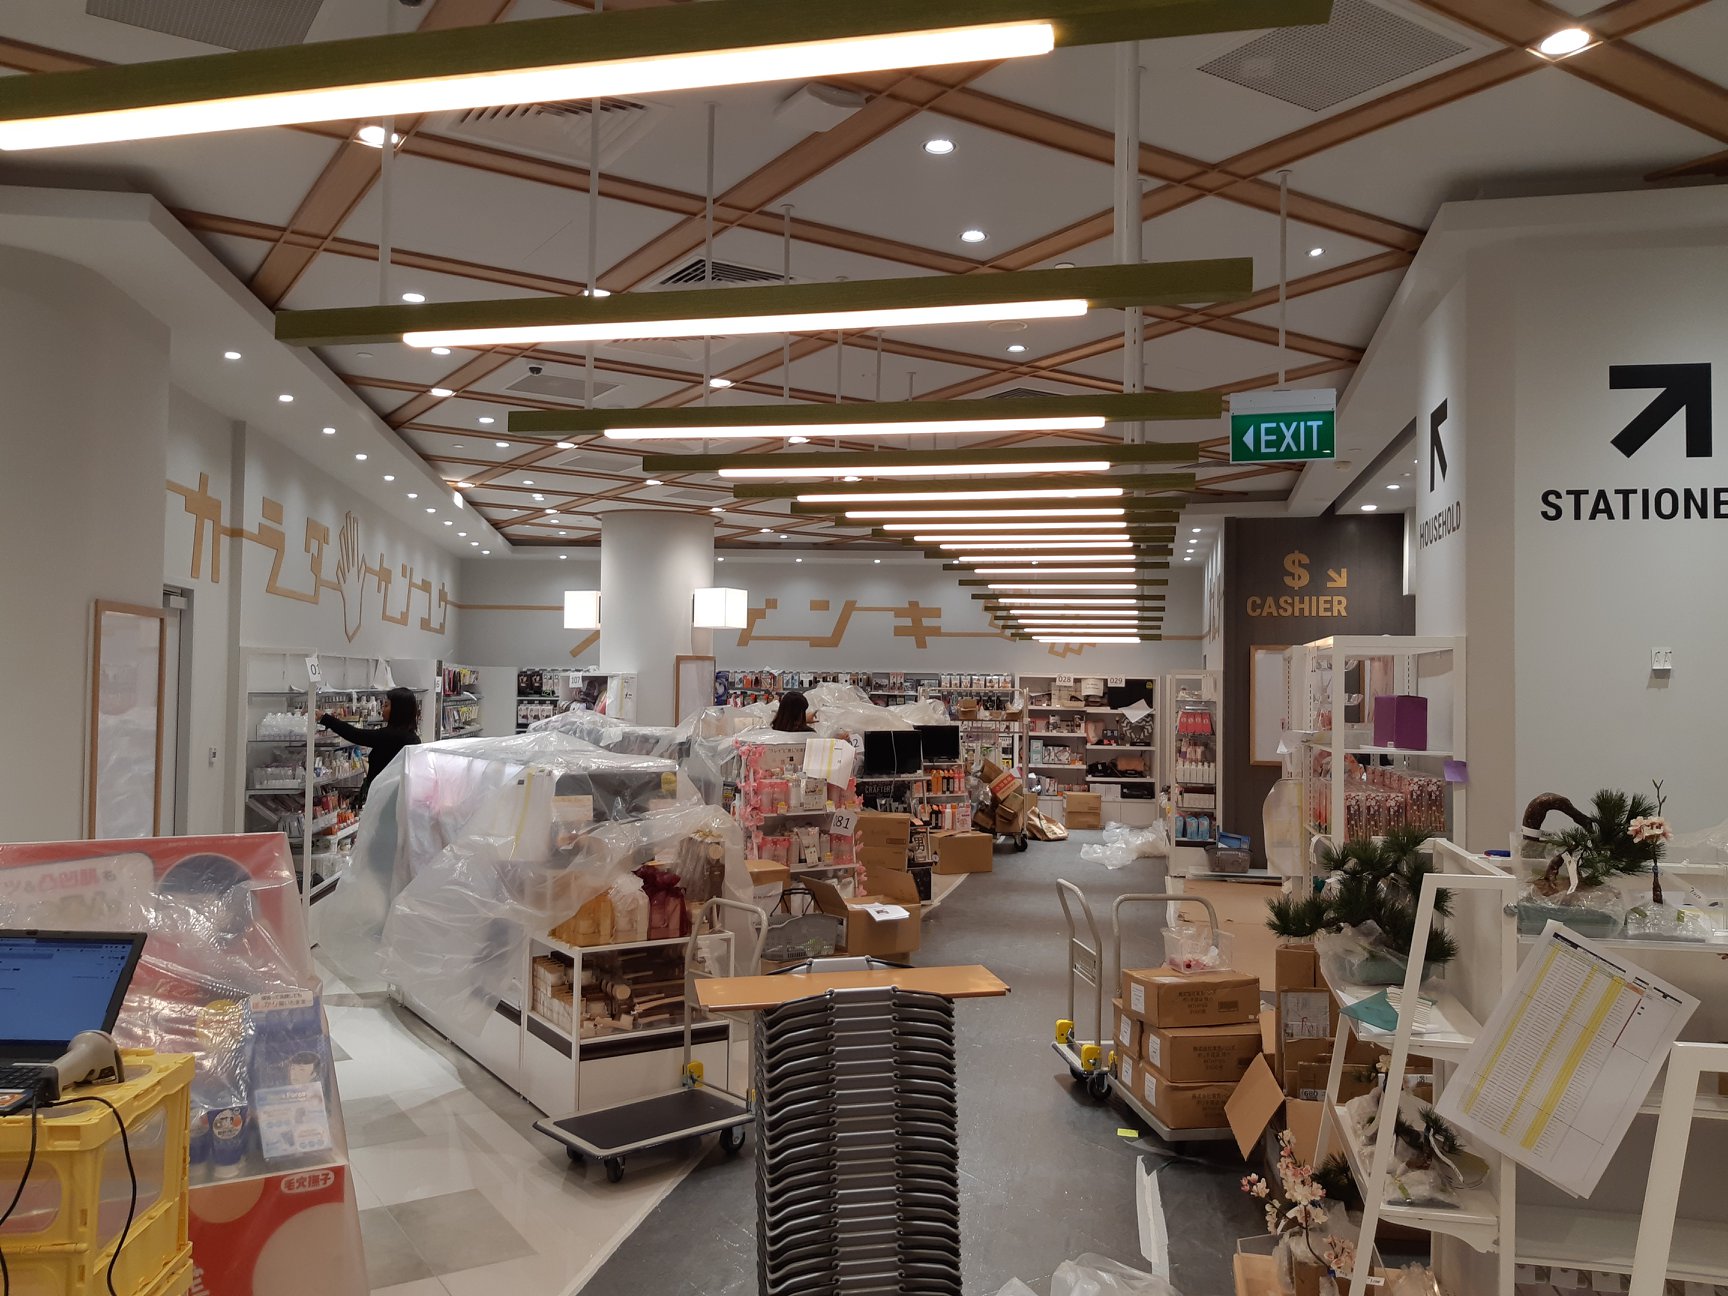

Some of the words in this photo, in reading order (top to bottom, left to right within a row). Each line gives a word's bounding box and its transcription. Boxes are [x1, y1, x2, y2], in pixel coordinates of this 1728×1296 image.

[1260, 420, 1323, 453] EXIT
[1540, 487, 1728, 521] STATIONE
[1419, 500, 1461, 550] HOUSEHOLD
[1246, 595, 1348, 617] CASHIER
[571, 676, 580, 685] 107
[284, 1172, 332, 1191] 毛穴撫子
